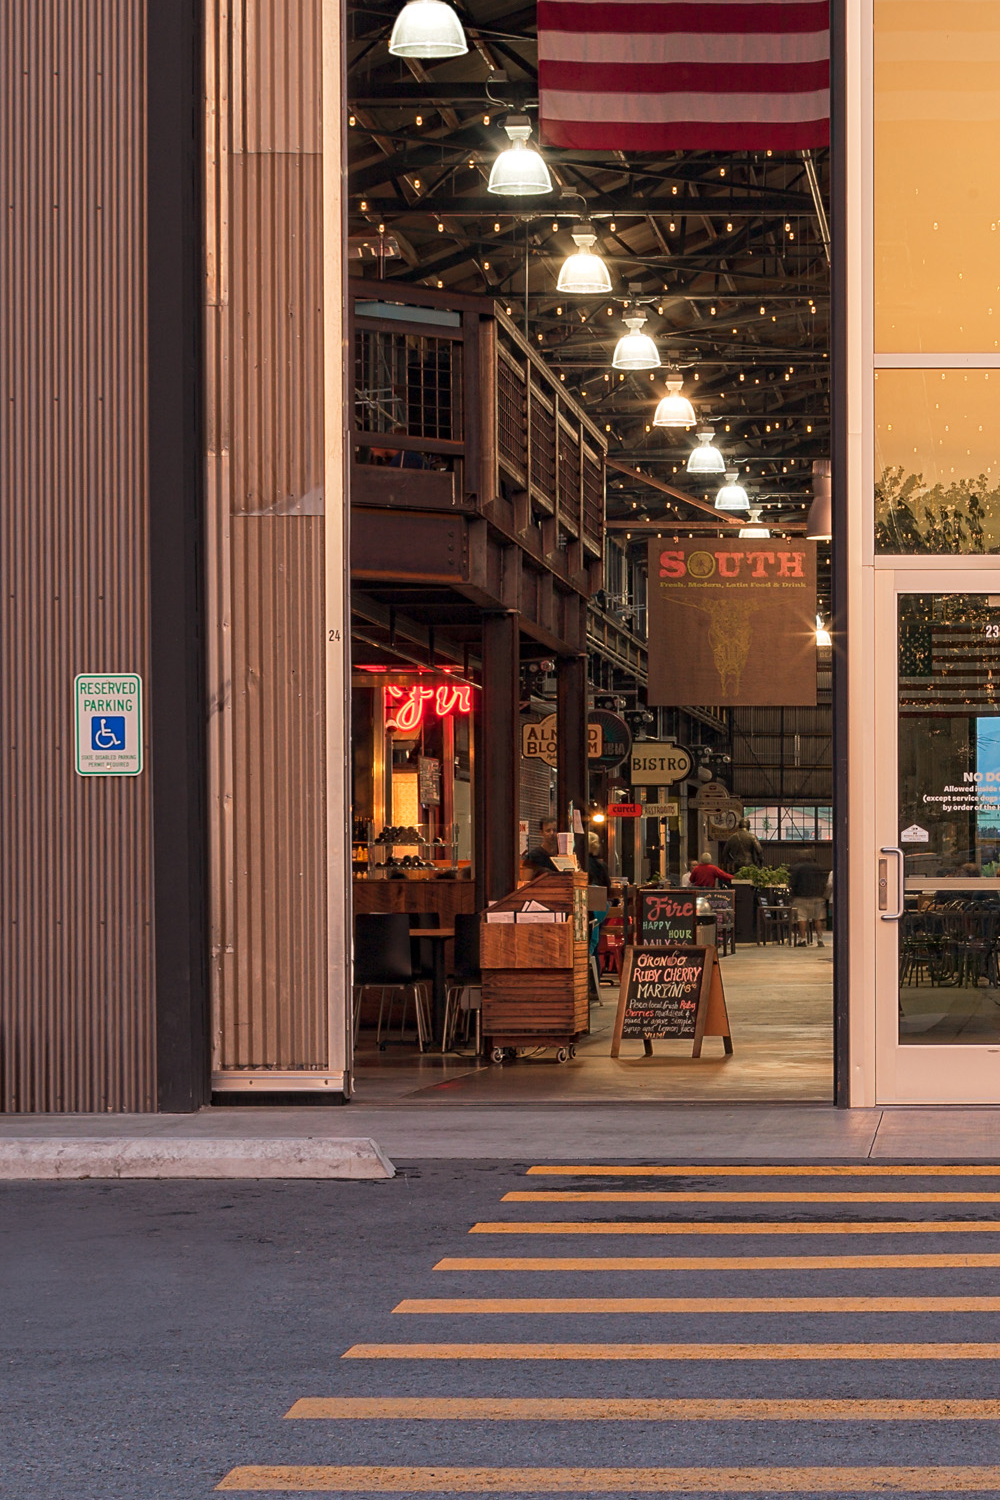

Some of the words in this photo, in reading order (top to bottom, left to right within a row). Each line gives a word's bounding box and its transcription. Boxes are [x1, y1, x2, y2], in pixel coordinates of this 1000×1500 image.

[659, 551, 806, 578] SOUTH
[328, 629, 341, 641] 24
[985, 624, 999, 638] 23
[80, 682, 136, 694] RESERVED
[84, 699, 133, 712] PARKING
[632, 757, 688, 770] BISTRO
[963, 772, 983, 782] NO
[922, 794, 952, 803] (except
[952, 794, 979, 802] service
[980, 794, 998, 804] dogs
[612, 804, 636, 813] cured
[942, 804, 952, 812] by
[646, 896, 694, 922] Fire
[642, 921, 671, 930] HAPPY
[668, 930, 692, 939] HOUR
[632, 967, 662, 982] RUBY
[663, 966, 702, 982] CHERRY
[637, 982, 685, 998] MARTINI
[680, 1000, 697, 1012] Ruby
[625, 1009, 655, 1017] Cherries
